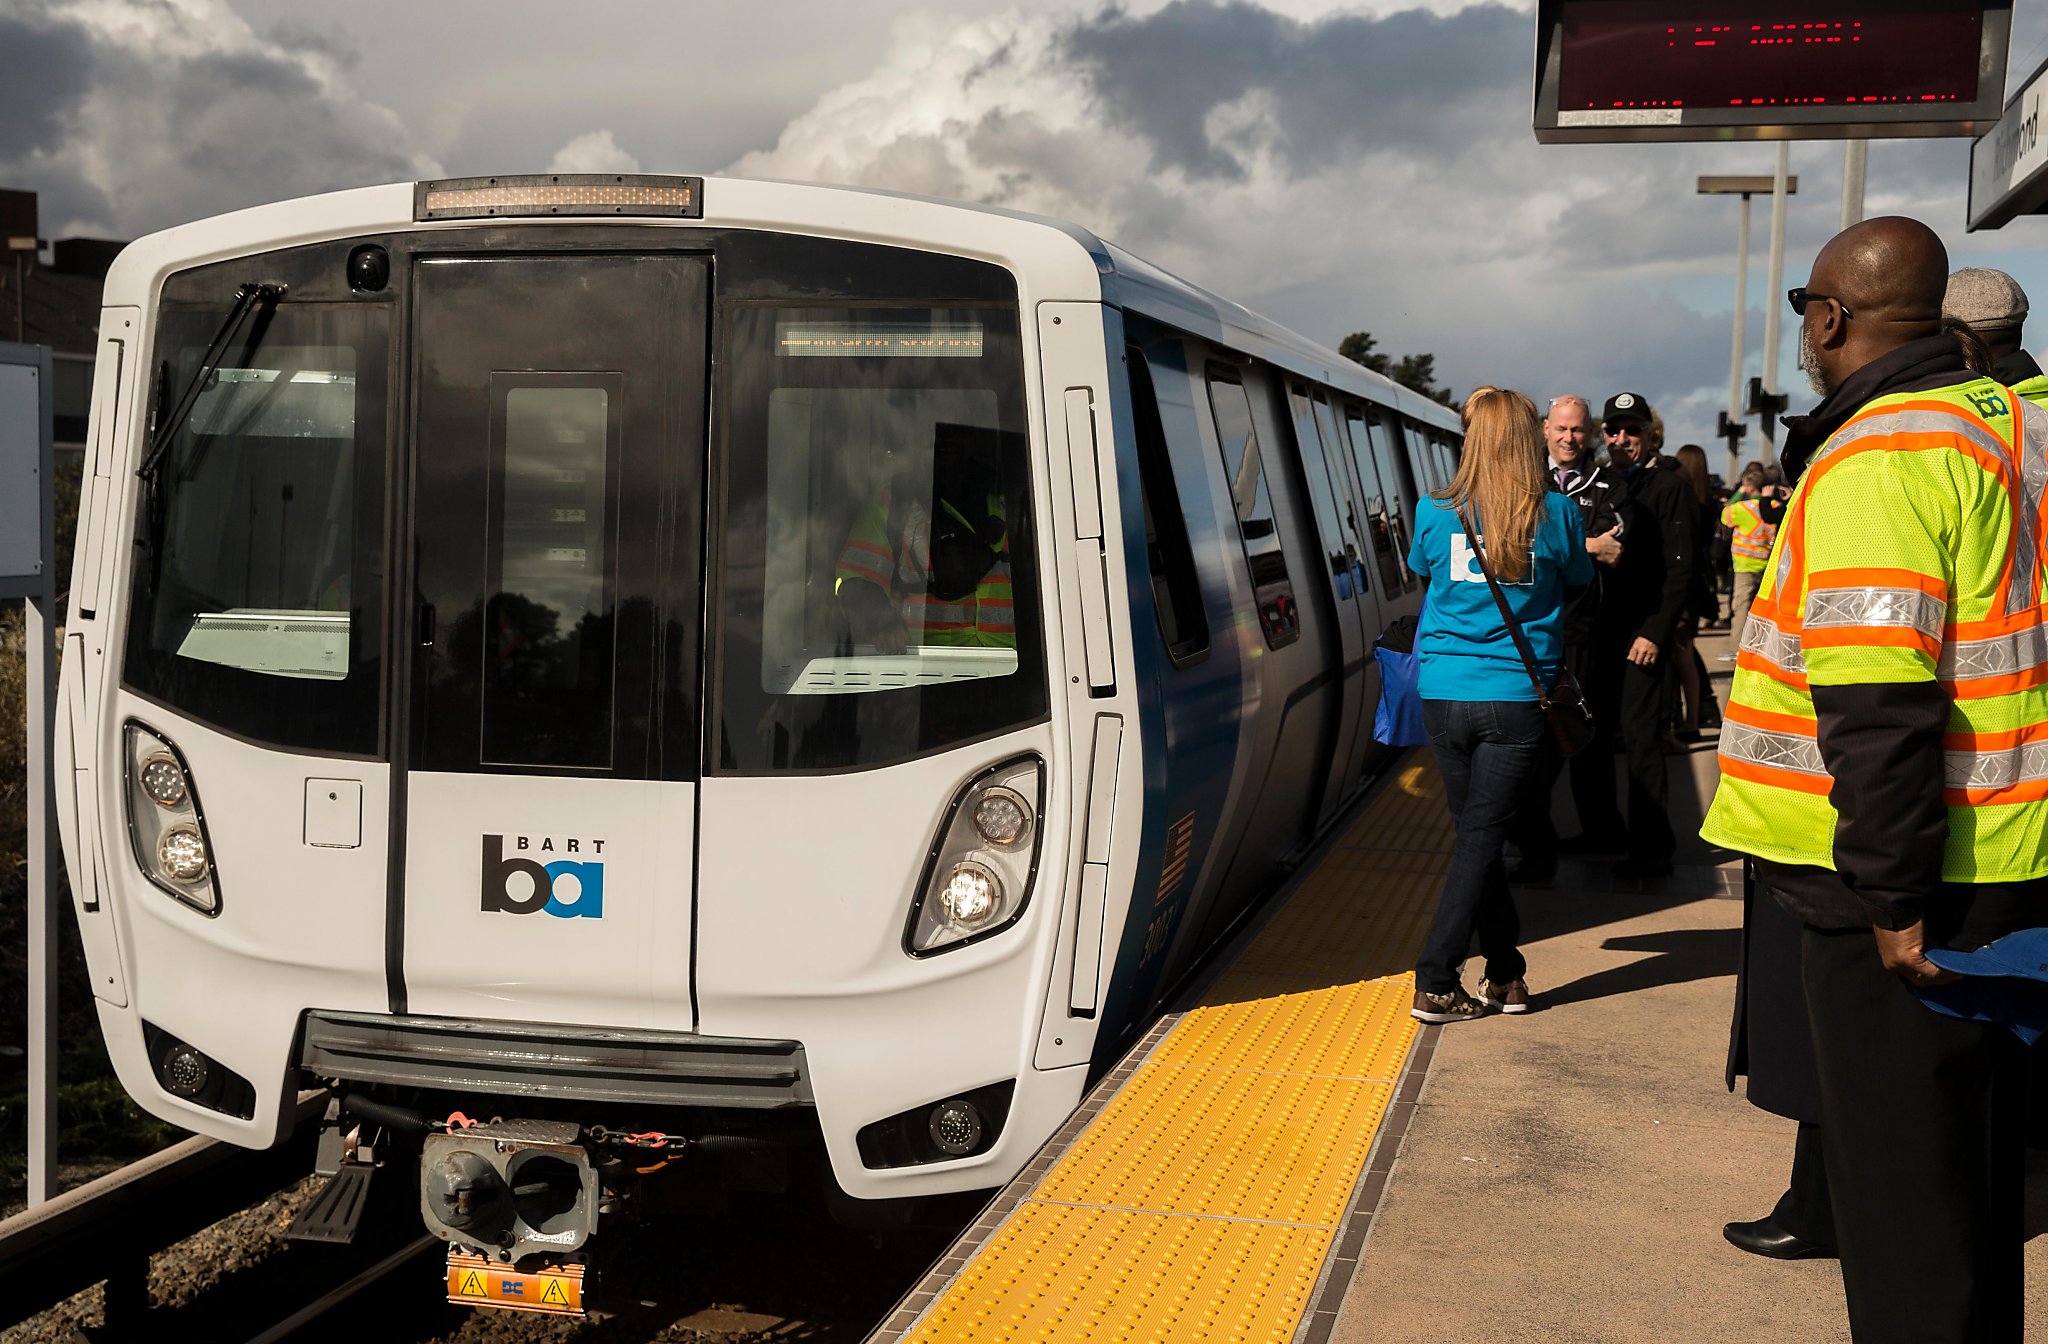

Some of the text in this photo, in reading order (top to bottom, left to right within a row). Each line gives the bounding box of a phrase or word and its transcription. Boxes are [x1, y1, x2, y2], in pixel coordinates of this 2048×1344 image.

[1561, 110, 1658, 126] PLATFORM
[517, 836, 605, 854] BART
[480, 834, 604, 919] ba
